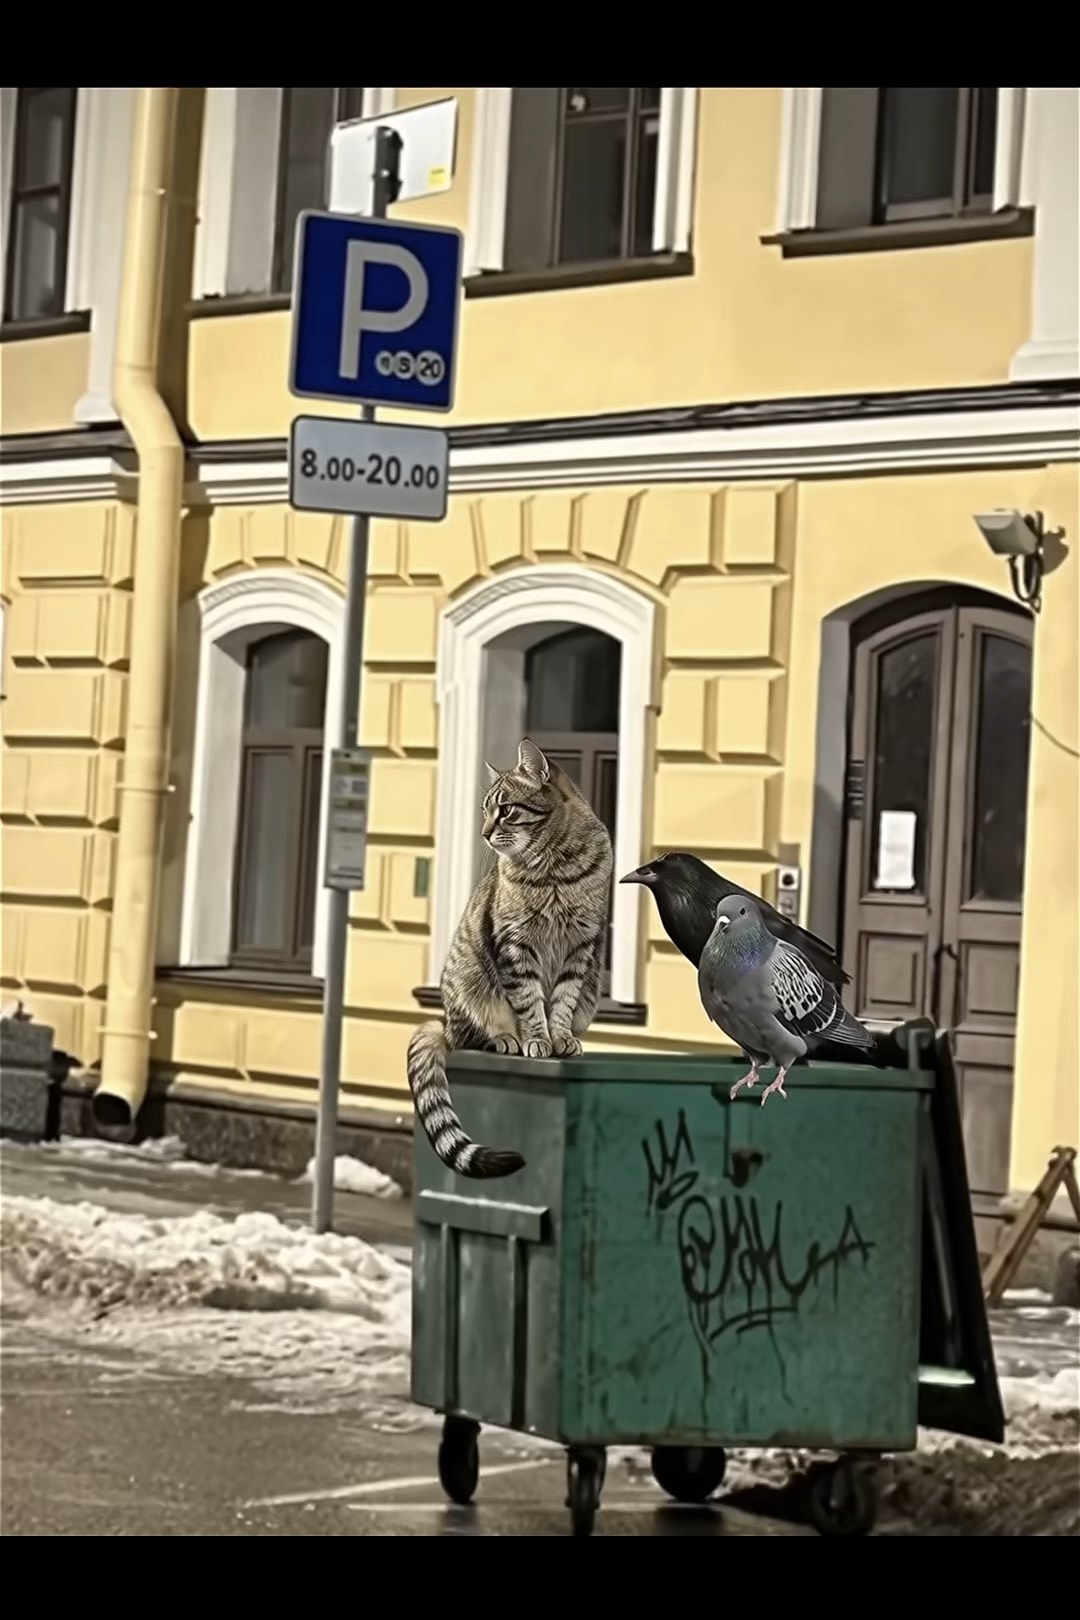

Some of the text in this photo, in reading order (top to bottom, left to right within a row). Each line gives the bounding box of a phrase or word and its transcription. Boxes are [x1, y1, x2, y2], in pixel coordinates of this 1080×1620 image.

[338, 238, 429, 380] P
[420, 357, 441, 379] 20
[300, 448, 440, 490] 8.00-20.00
